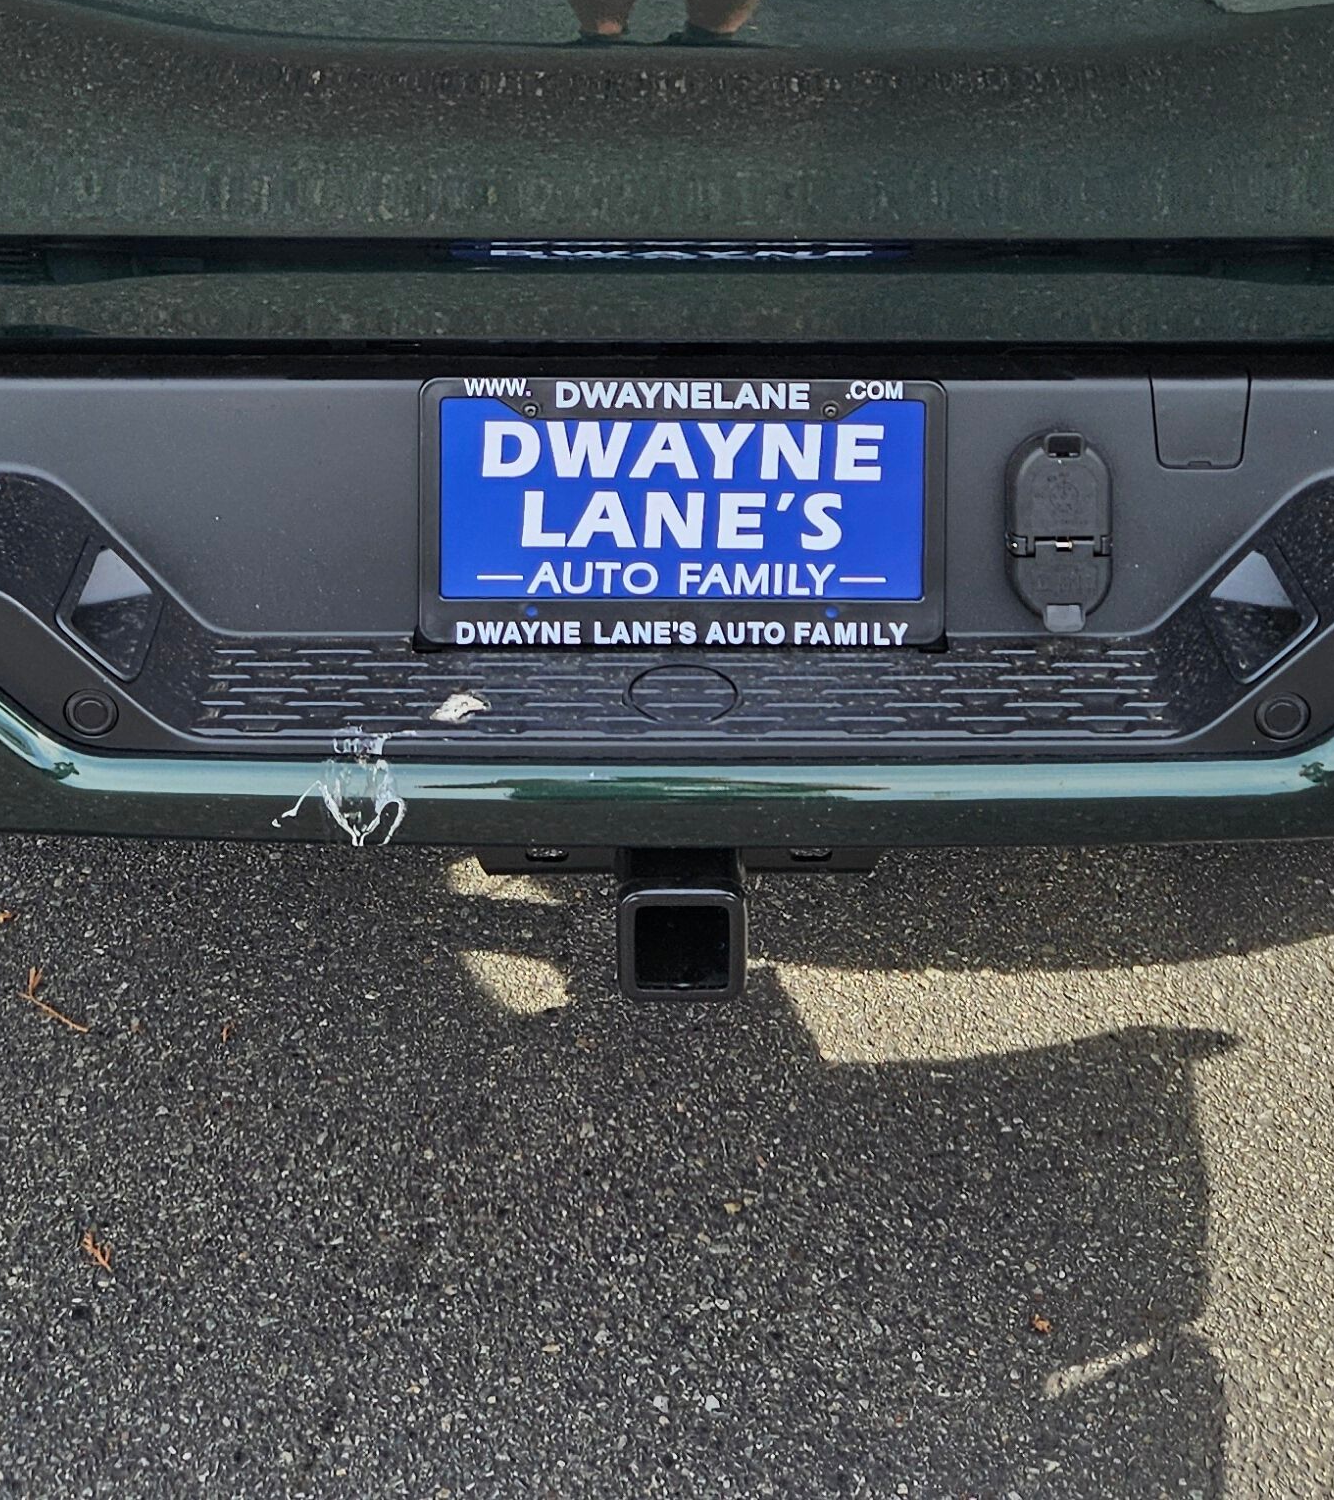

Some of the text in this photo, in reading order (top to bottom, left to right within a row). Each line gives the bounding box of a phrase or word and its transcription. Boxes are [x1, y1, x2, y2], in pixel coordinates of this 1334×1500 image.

[463, 377, 905, 411] WWW. DWAYNELANE .COM
[481, 419, 886, 481] DWAYNE
[520, 489, 843, 551] LANE'S
[526, 560, 836, 596] AUTO FAMILY
[455, 620, 909, 646] DWAYNE LANE'S AUTO FAMILY
